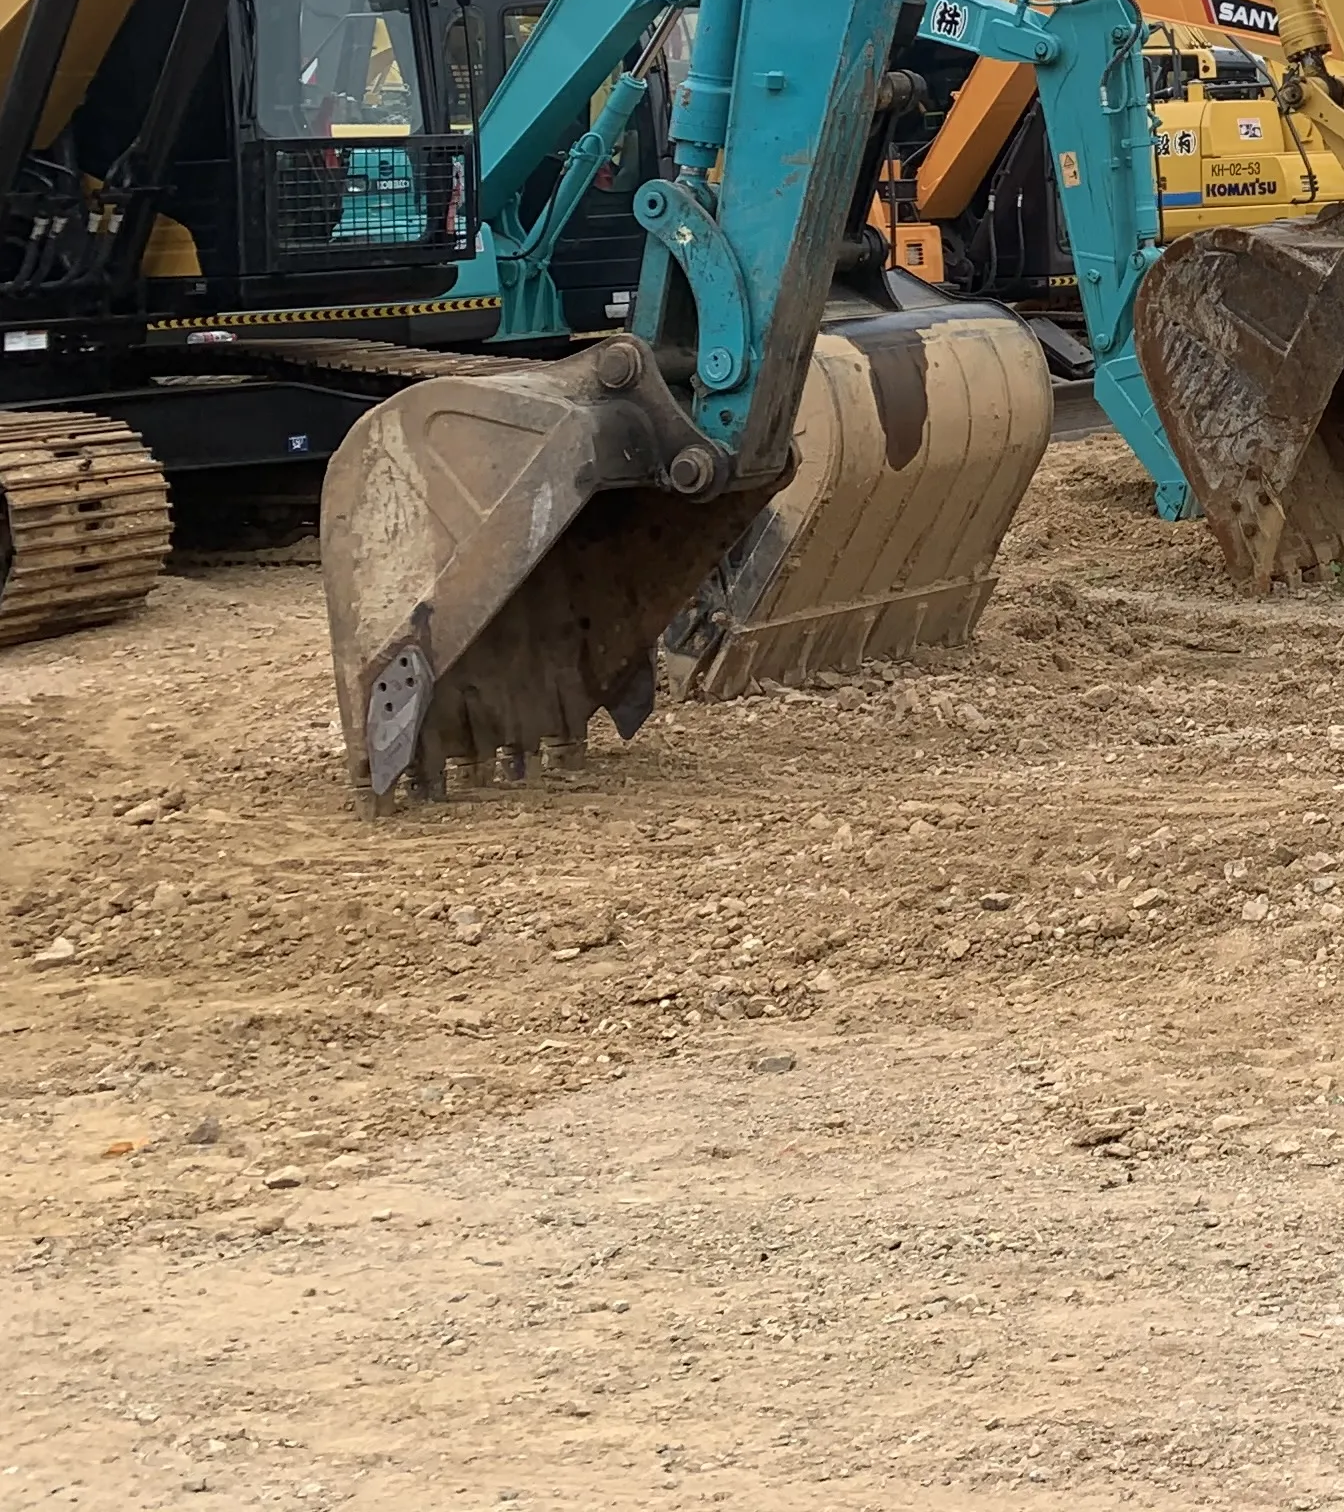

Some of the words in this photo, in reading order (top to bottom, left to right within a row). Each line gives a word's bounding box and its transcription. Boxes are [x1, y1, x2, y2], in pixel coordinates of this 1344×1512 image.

[1218, 1, 1279, 32] SANY
[1211, 161, 1261, 178] KH-02-53
[1205, 178, 1277, 198] KOMATSU
